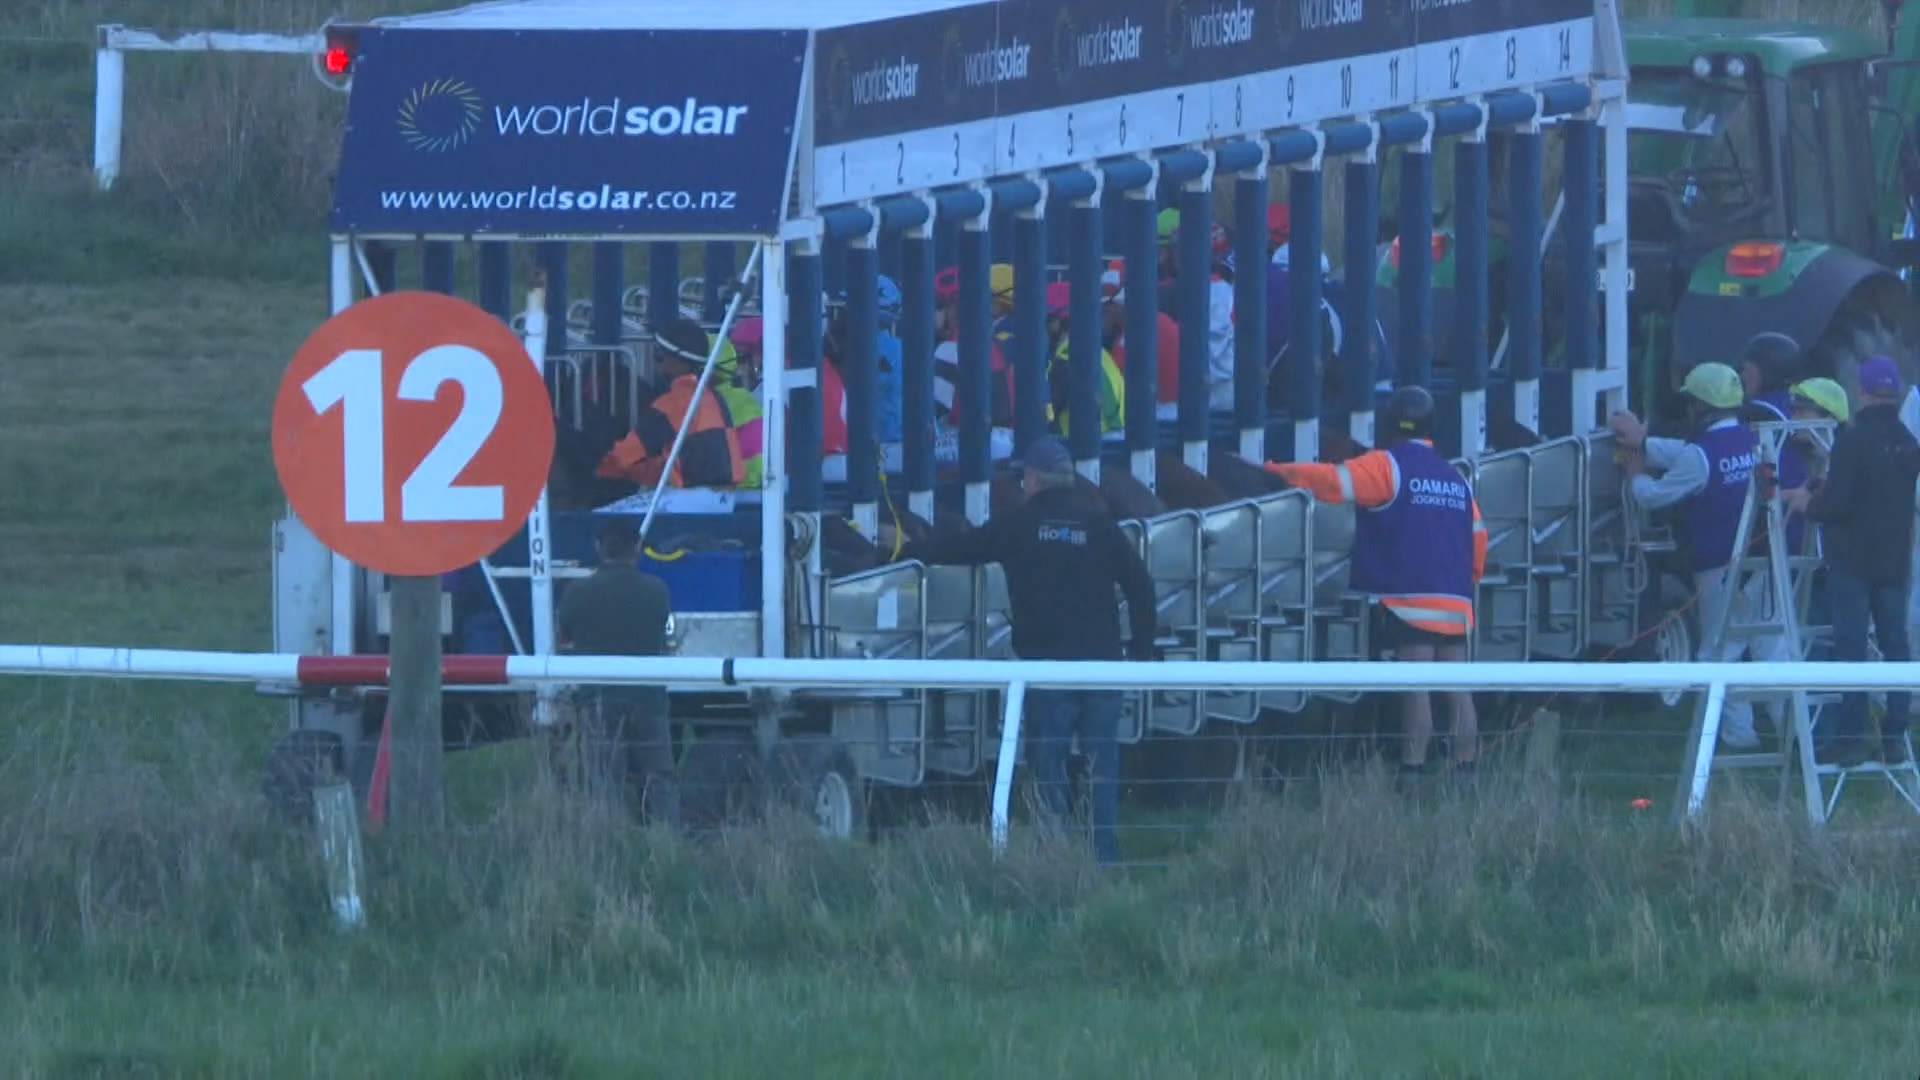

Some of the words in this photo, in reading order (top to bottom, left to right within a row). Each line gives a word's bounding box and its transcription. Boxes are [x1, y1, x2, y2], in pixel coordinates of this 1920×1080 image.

[965, 37, 1030, 85] worldsolar
[1078, 16, 1142, 67] worldsolar
[852, 56, 918, 104] worldsolar
[495, 97, 748, 136] worldsolar
[840, 152, 847, 192] 1
[898, 141, 904, 185] 2
[953, 131, 960, 176] 3
[1008, 121, 1016, 166] 4
[1066, 112, 1073, 157] 5
[1119, 102, 1126, 147] 6
[1177, 92, 1184, 137] 7
[1235, 83, 1242, 128] 8
[1287, 74, 1294, 119] 9
[1341, 64, 1351, 109] 10
[1389, 54, 1399, 100] 11
[1449, 45, 1460, 90] 12
[1506, 36, 1516, 79] 13
[1559, 28, 1570, 71] 14
[380, 185, 737, 210] www.worldsolar.co.nz
[301, 344, 504, 522] 12
[1410, 478, 1465, 498] OAMARU
